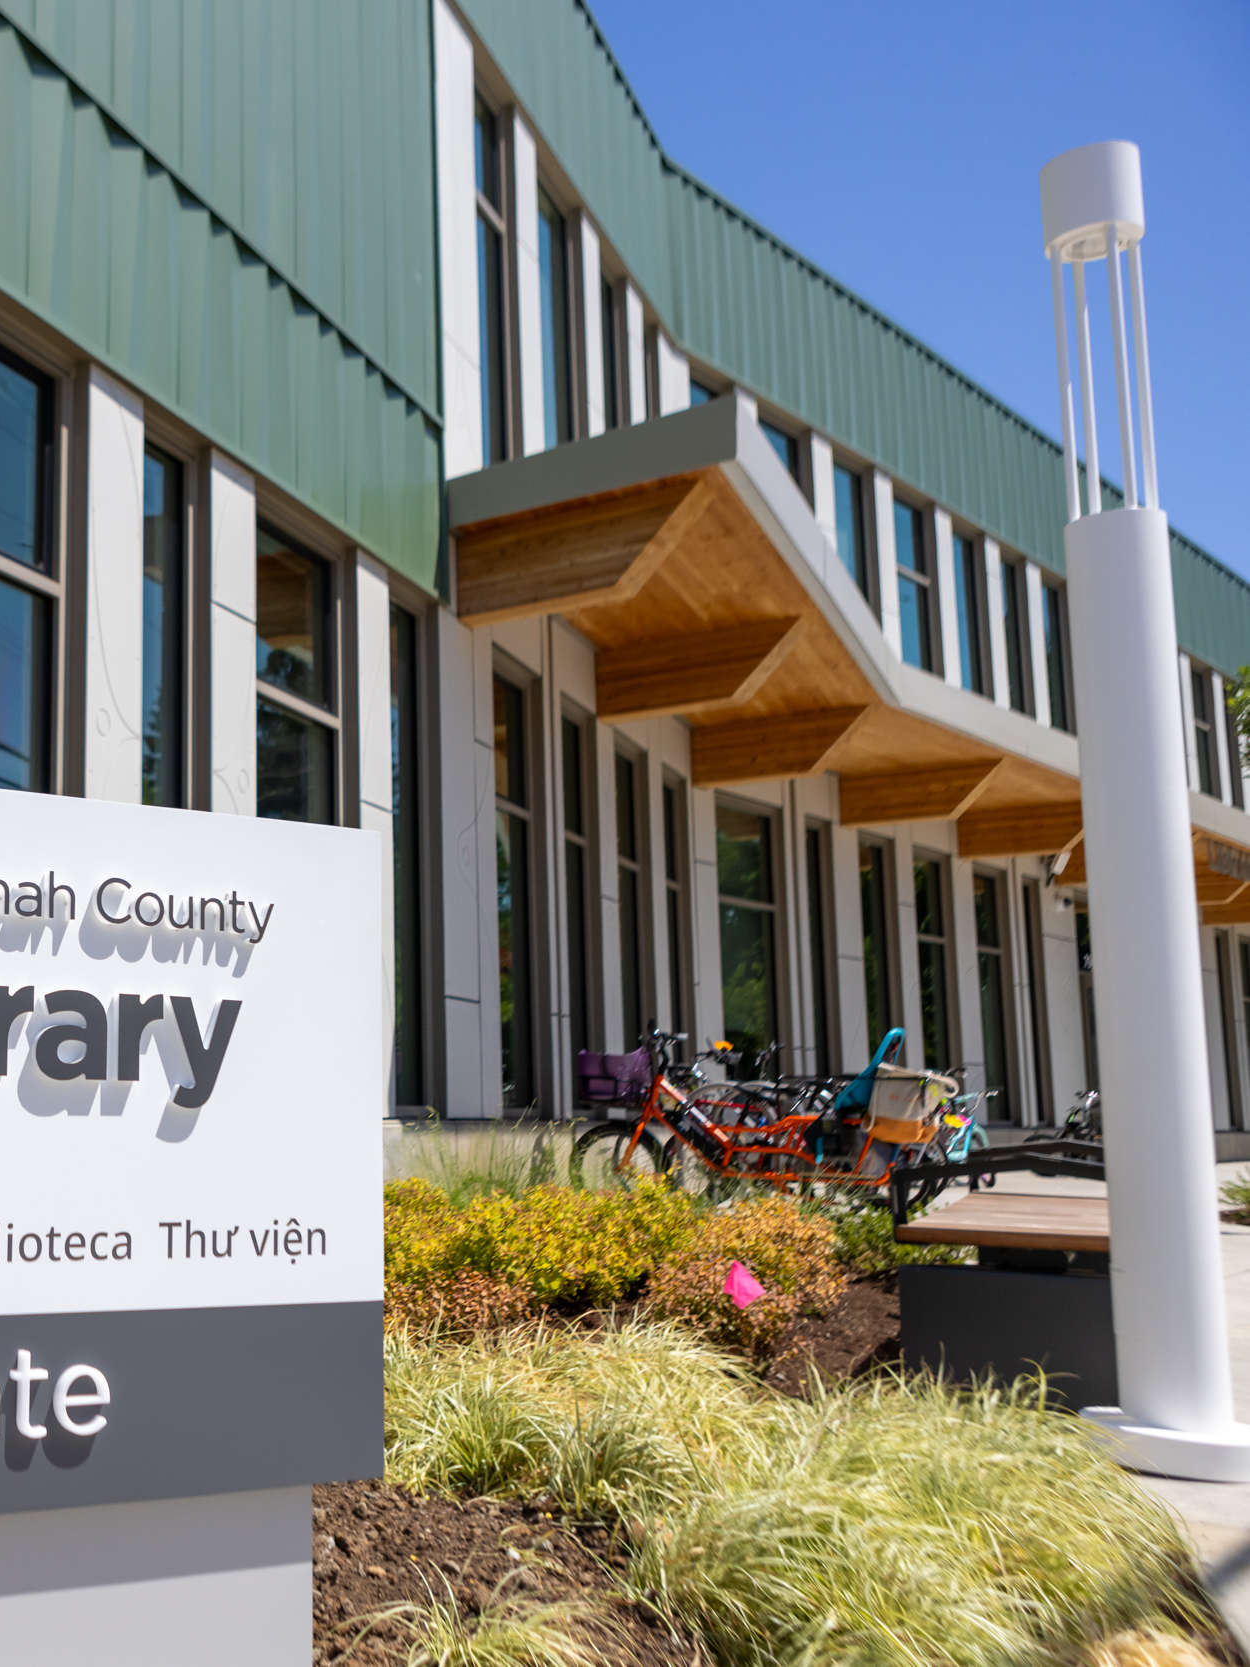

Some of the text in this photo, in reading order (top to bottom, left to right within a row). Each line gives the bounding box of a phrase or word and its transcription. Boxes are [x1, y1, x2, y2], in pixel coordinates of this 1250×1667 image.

[96, 877, 275, 944] County
[159, 1218, 327, 1265] Thư viện
